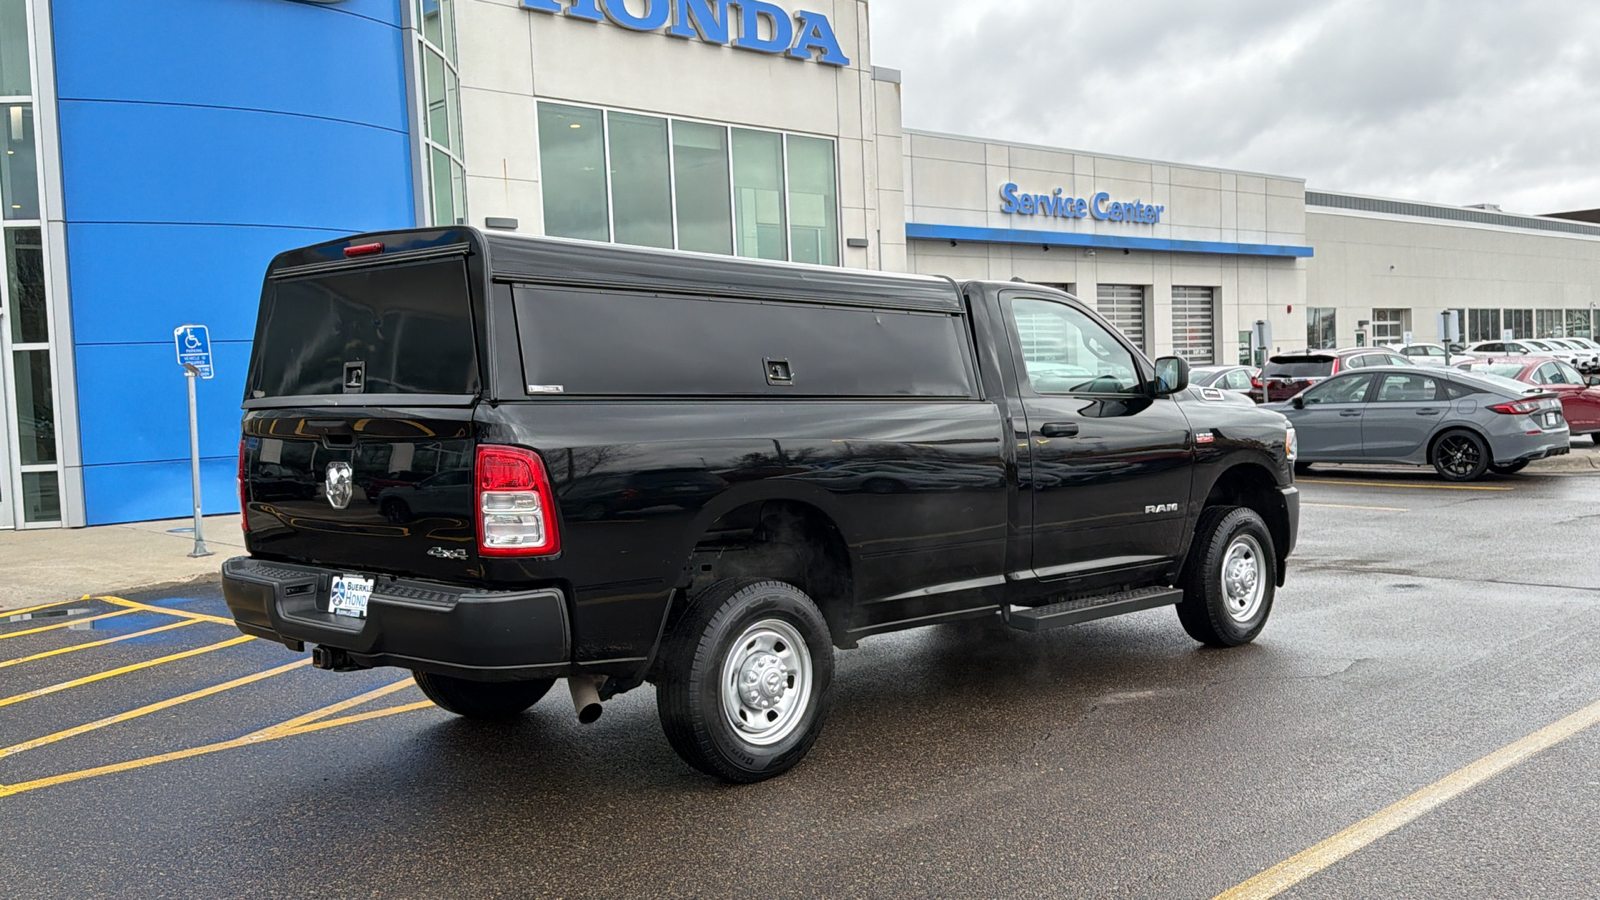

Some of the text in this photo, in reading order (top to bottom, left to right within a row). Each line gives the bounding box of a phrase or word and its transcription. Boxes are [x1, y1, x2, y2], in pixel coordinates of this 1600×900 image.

[519, 0, 850, 66] ONDA
[1000, 182, 1165, 224] Service Center
[1144, 503, 1178, 514] RAM
[345, 591, 366, 606] HOND
